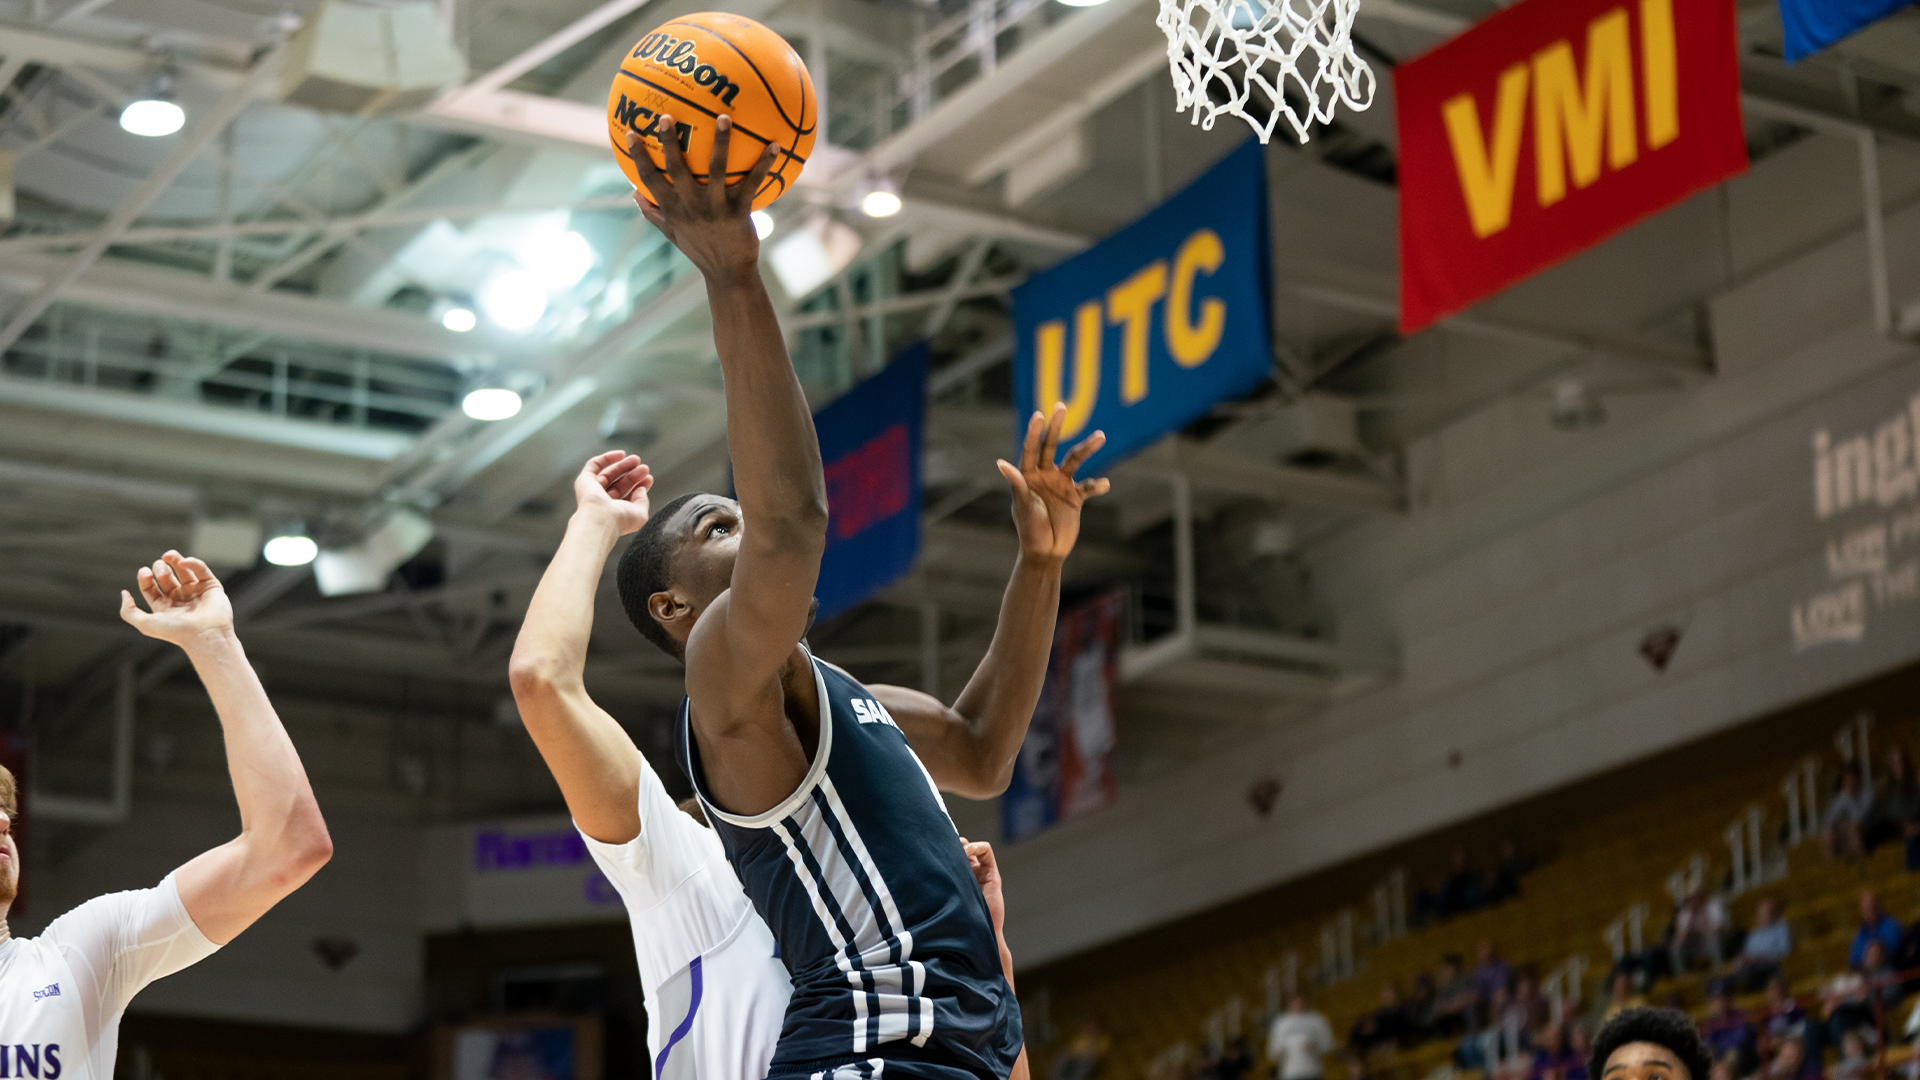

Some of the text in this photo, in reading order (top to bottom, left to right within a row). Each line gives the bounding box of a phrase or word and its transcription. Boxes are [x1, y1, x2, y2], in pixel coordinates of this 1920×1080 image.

[613, 92, 693, 154] NCAA
[632, 32, 741, 108] Wilson
[1442, 0, 1680, 239] VMI
[1034, 228, 1227, 443] UTC
